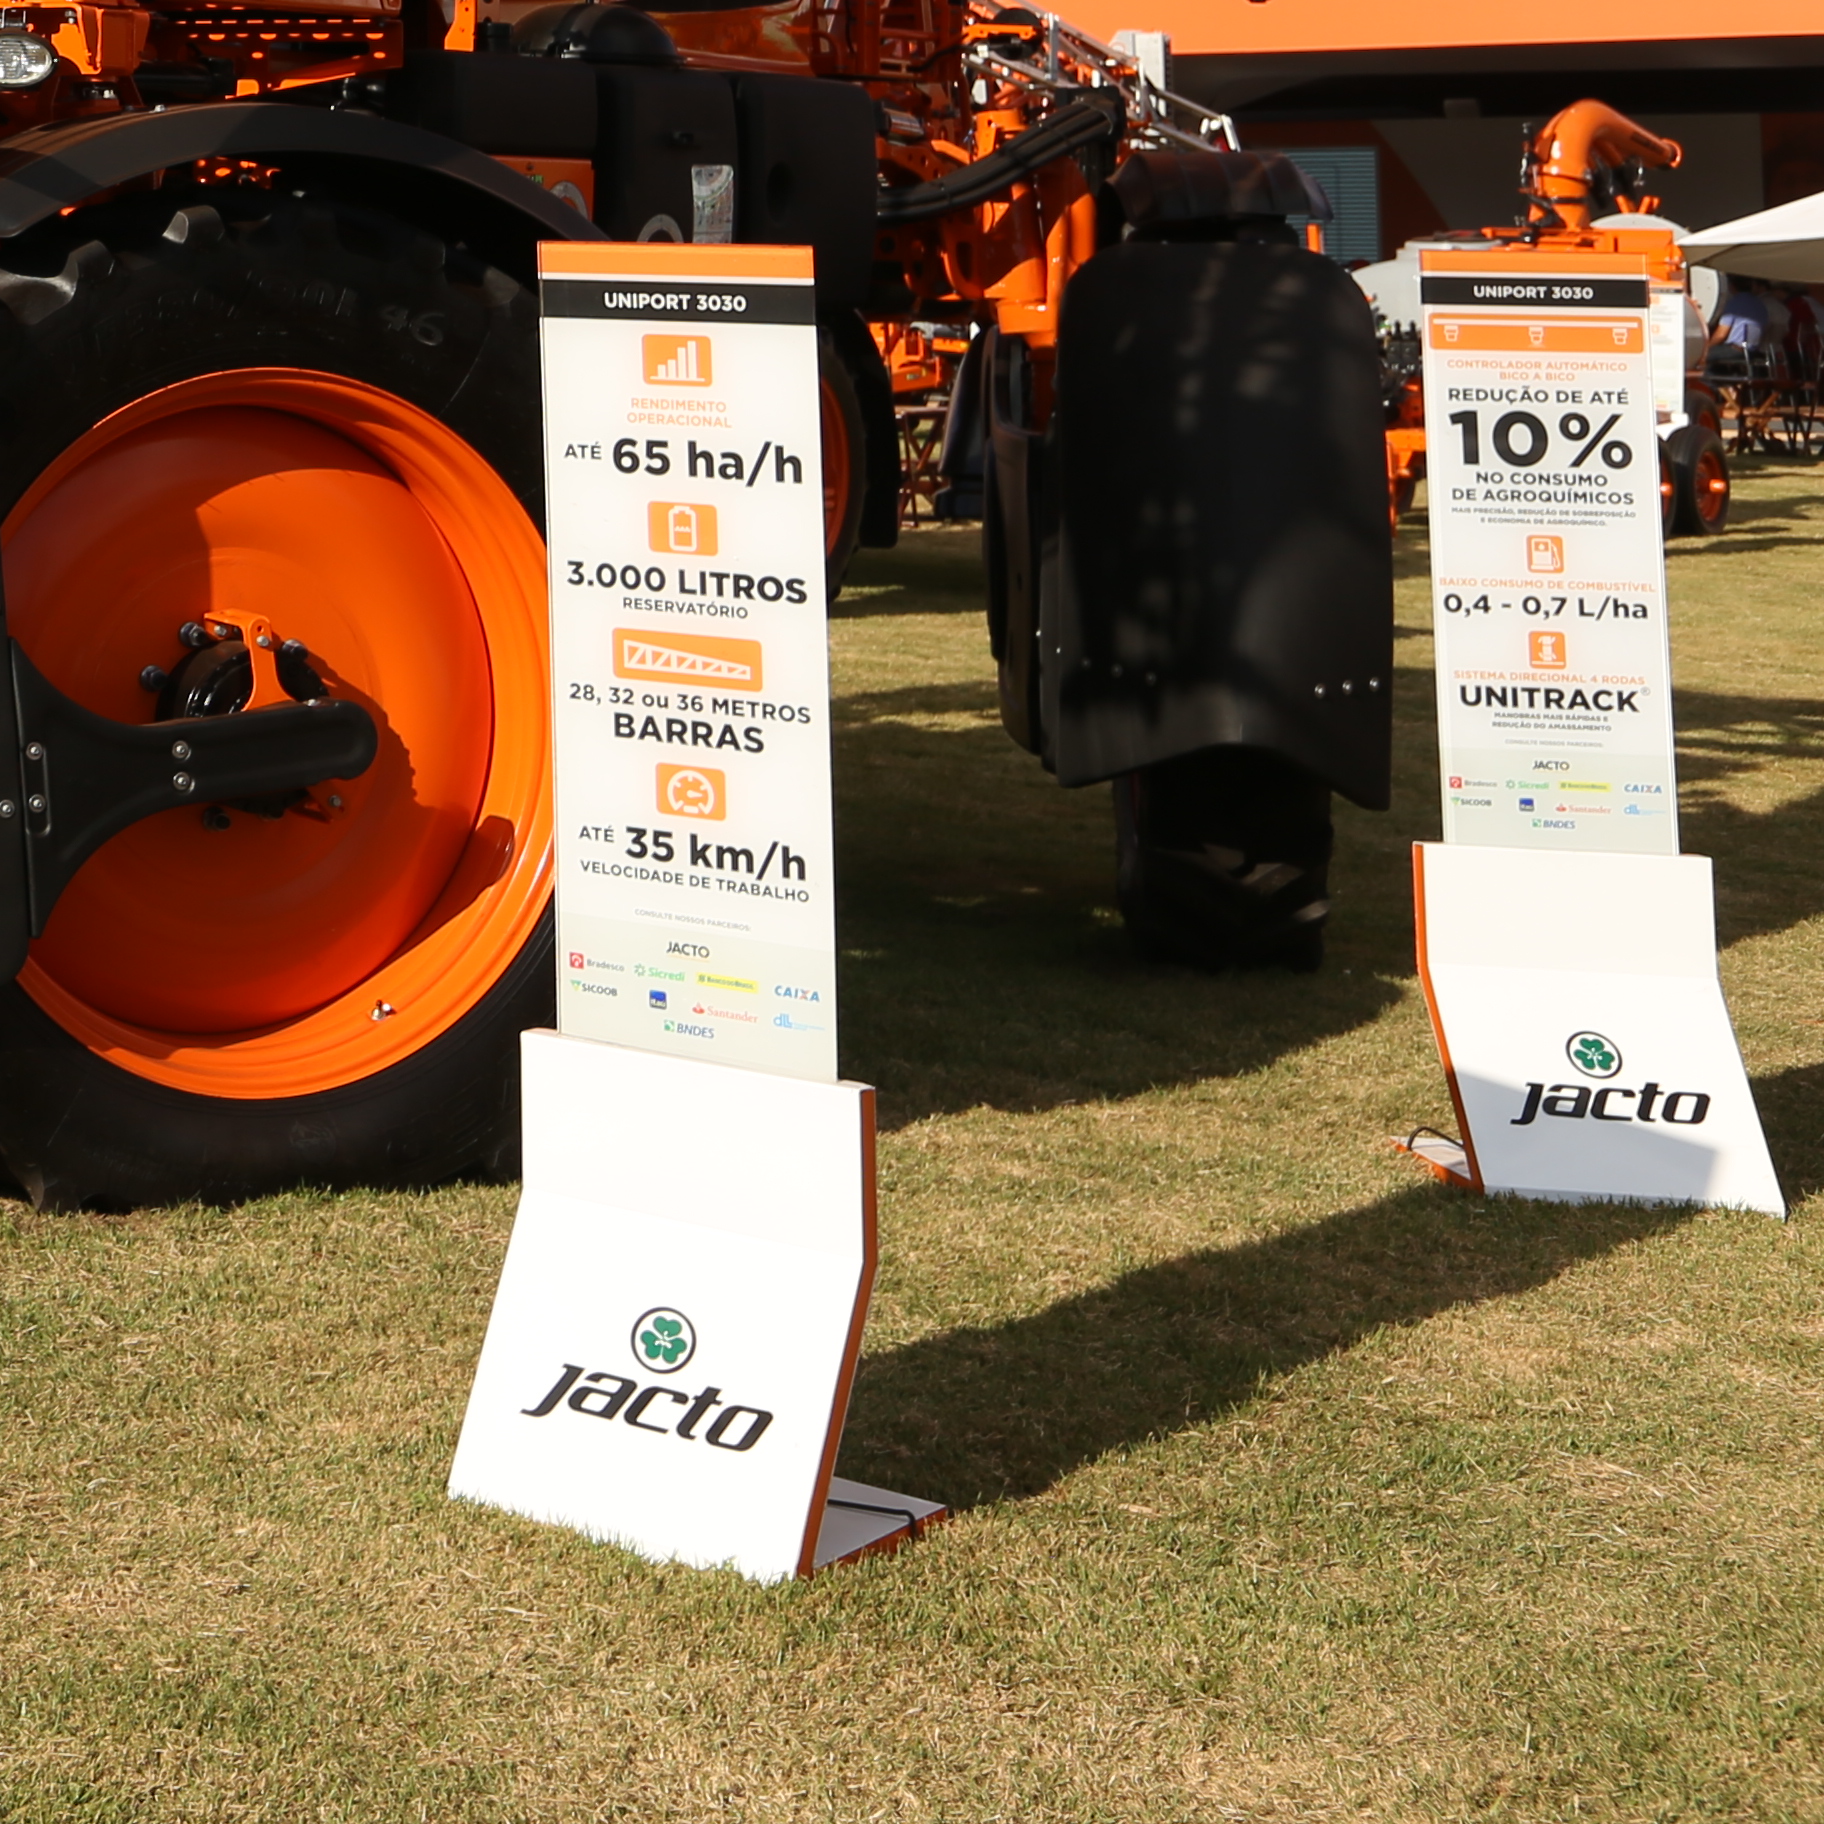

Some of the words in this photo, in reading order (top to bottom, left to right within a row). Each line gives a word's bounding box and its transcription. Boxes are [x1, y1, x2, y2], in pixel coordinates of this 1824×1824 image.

[1473, 285, 1547, 300] UNIPORT
[1552, 286, 1594, 300] 3030
[604, 292, 691, 311] UNIPORT
[696, 294, 747, 312] 3030
[1447, 359, 1542, 371] CONTROLADOR
[1545, 359, 1628, 372] AUTOMÁTICO
[1499, 371, 1530, 382] BICO
[1533, 372, 1543, 382] A
[1545, 372, 1576, 382] BICO
[1448, 386, 1550, 405] REDUÇÃO
[1555, 390, 1584, 404] DE
[1589, 388, 1630, 405] ATÉ
[630, 397, 727, 413] RENDIMENTO
[626, 412, 732, 428] OPERACIONAL
[1448, 409, 1633, 470] 10%
[564, 441, 602, 460] ATÉ
[613, 437, 671, 476] 65
[687, 440, 803, 488] ha/h
[1475, 471, 1505, 486] NO
[1509, 472, 1608, 487] CONSUMO
[1451, 488, 1477, 501] DE
[1483, 487, 1635, 505] AGROQUÍMICOS
[1517, 507, 1557, 517] REDUÇÃO
[1559, 509, 1571, 517] DE
[567, 560, 666, 592] 3.000
[678, 568, 808, 605] LITROS
[1439, 577, 1478, 587] BAIXO
[1480, 578, 1544, 590] CONSUMO
[1548, 579, 1565, 590] DE
[1568, 579, 1656, 593] COMBUSTÍVEL
[623, 596, 749, 619] RESERVATÓRIO
[1443, 593, 1492, 617] 0,4
[1522, 595, 1568, 620] 0,7
[1578, 595, 1649, 621] L/ha
[1453, 669, 1506, 681] SISTEMA
[1510, 672, 1587, 684] DIRECIONAL
[1589, 675, 1599, 684] 4
[1602, 675, 1645, 686] RODAS
[569, 683, 602, 706] 28,
[608, 687, 635, 706] 32
[642, 693, 669, 709] ou
[676, 693, 704, 713] 36
[712, 697, 812, 724] METROS
[1492, 721, 1532, 730] REDUÇÃO
[1548, 723, 1612, 732] AMASSAMENTO
[1543, 713, 1563, 721] MAIS
[1565, 713, 1601, 722] RÁPIDAS
[613, 712, 765, 754] BARRAS
[1532, 760, 1570, 771] JACTO
[1518, 780, 1550, 790] Sicredi
[1624, 784, 1663, 794] CAIXA
[1461, 798, 1492, 807] SICOOB
[1568, 804, 1612, 815] Santander
[1543, 820, 1576, 830] BNDES
[579, 825, 615, 843] ATÉ
[625, 826, 675, 863] 35
[689, 833, 807, 881] km/h
[580, 859, 685, 886] VELOCIDADE
[689, 875, 711, 890] DE
[716, 878, 810, 903] TRABALHO
[634, 908, 673, 921] CONSULTE
[675, 914, 705, 926] NOSSOS
[666, 941, 710, 959] JACTO
[586, 958, 625, 973] Bradesco
[648, 967, 686, 983] Sicredi
[774, 985, 821, 1003] CAIXA
[581, 982, 618, 998] SICOOB
[707, 1005, 759, 1025] Santander
[677, 1023, 715, 1040] BNDES
[1510, 1081, 1711, 1126] jacto
[520, 1363, 774, 1452] jacto
